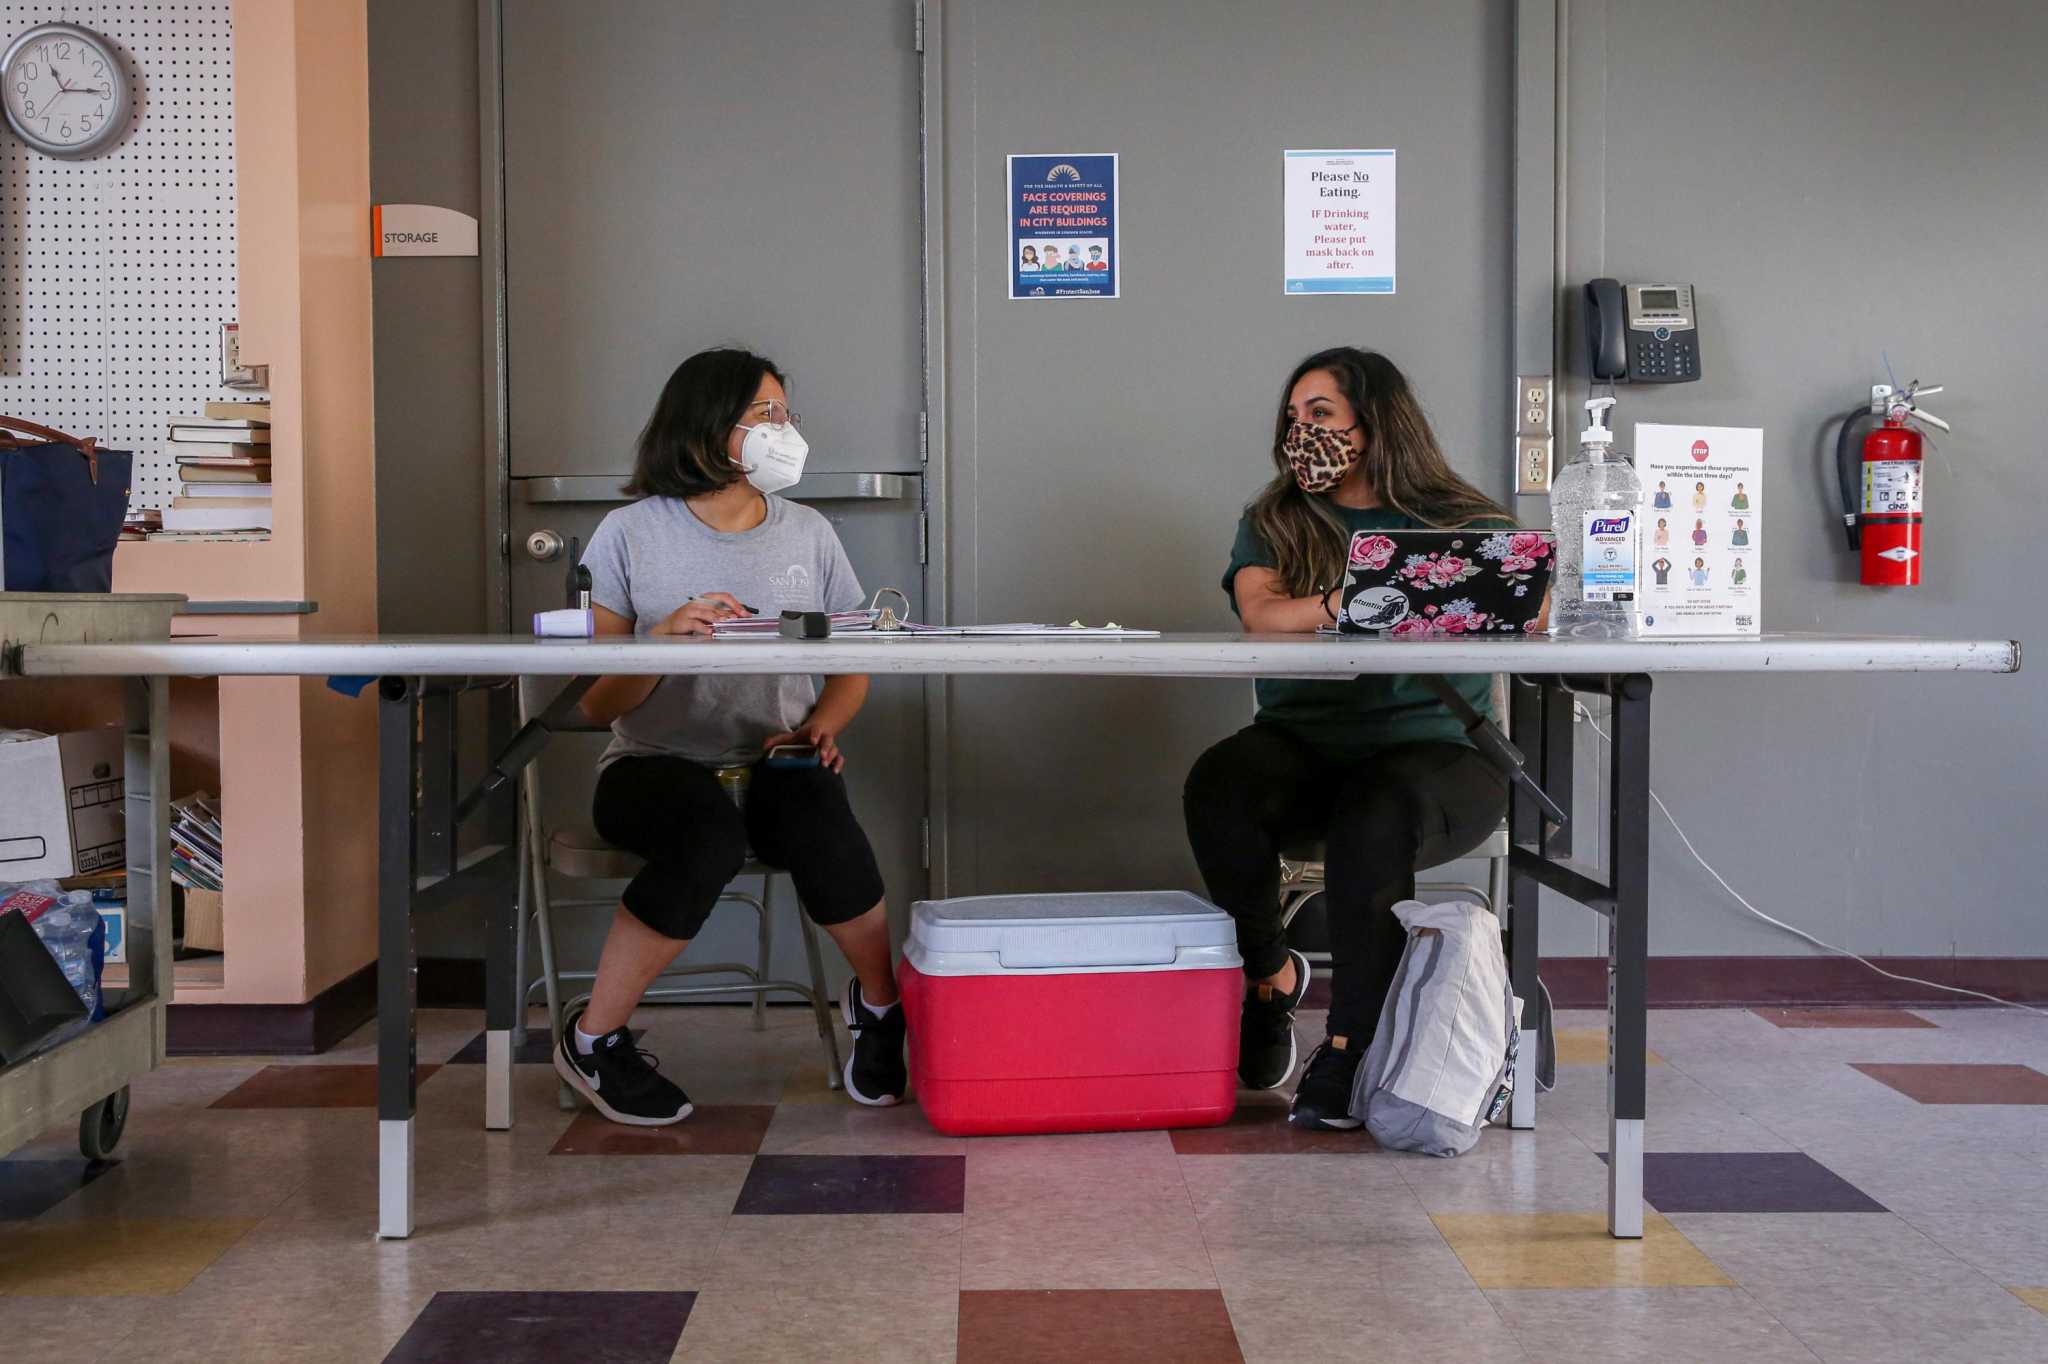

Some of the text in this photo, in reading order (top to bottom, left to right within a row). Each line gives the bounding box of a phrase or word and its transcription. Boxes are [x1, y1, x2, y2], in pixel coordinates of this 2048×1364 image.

[39, 44, 49, 63] 11
[54, 42, 71, 60] 12
[18, 62, 38, 81] 10
[92, 60, 103, 78] 2
[17, 82, 29, 99] 9
[100, 81, 112, 101] 3
[24, 100, 36, 119] 8
[93, 103, 105, 120] 4
[40, 116, 50, 133] 7
[60, 120, 72, 138] 6
[80, 114, 92, 132] 5
[1311, 171, 1369, 182] Please No
[1022, 192, 1107, 202] FACE COVERINGS
[1319, 187, 1361, 199] Eating.
[1029, 204, 1098, 215] ARE REQUIRED
[1311, 209, 1369, 220] IF Drinking
[1020, 217, 1108, 227] IN CITY BUILDINGS
[1324, 223, 1357, 232] water,
[384, 232, 438, 243] STORAGE
[1314, 235, 1366, 245] Please put
[1305, 248, 1375, 257] mask back on
[1326, 260, 1354, 269] after.
[1664, 464, 1675, 472] you
[1675, 464, 1707, 472] experienced
[1718, 472, 1733, 480] days?
[1595, 519, 1627, 532] Purell
